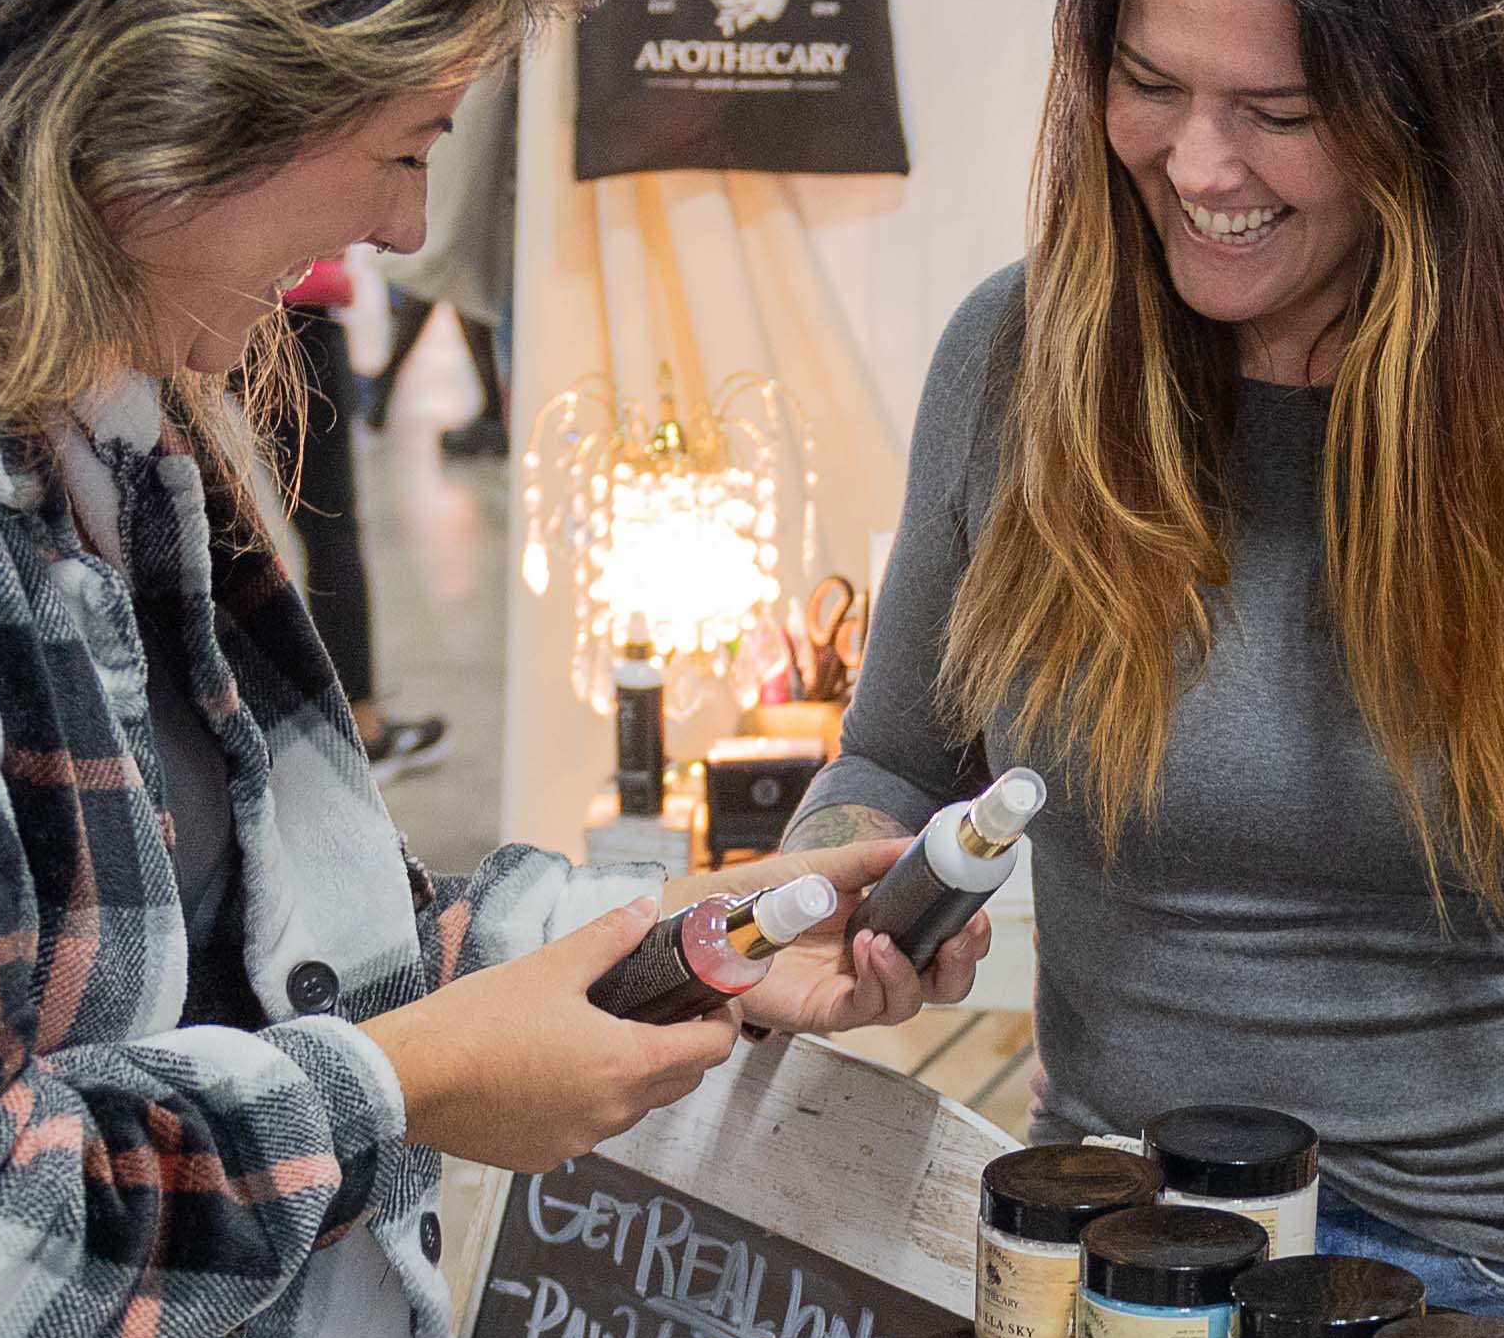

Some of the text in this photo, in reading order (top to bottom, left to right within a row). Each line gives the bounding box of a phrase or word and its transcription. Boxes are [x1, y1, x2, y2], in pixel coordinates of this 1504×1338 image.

[634, 39, 851, 74] APOTHECARY
[634, 1196, 778, 1337] REAL
[1008, 1321, 1035, 1338] SKY
